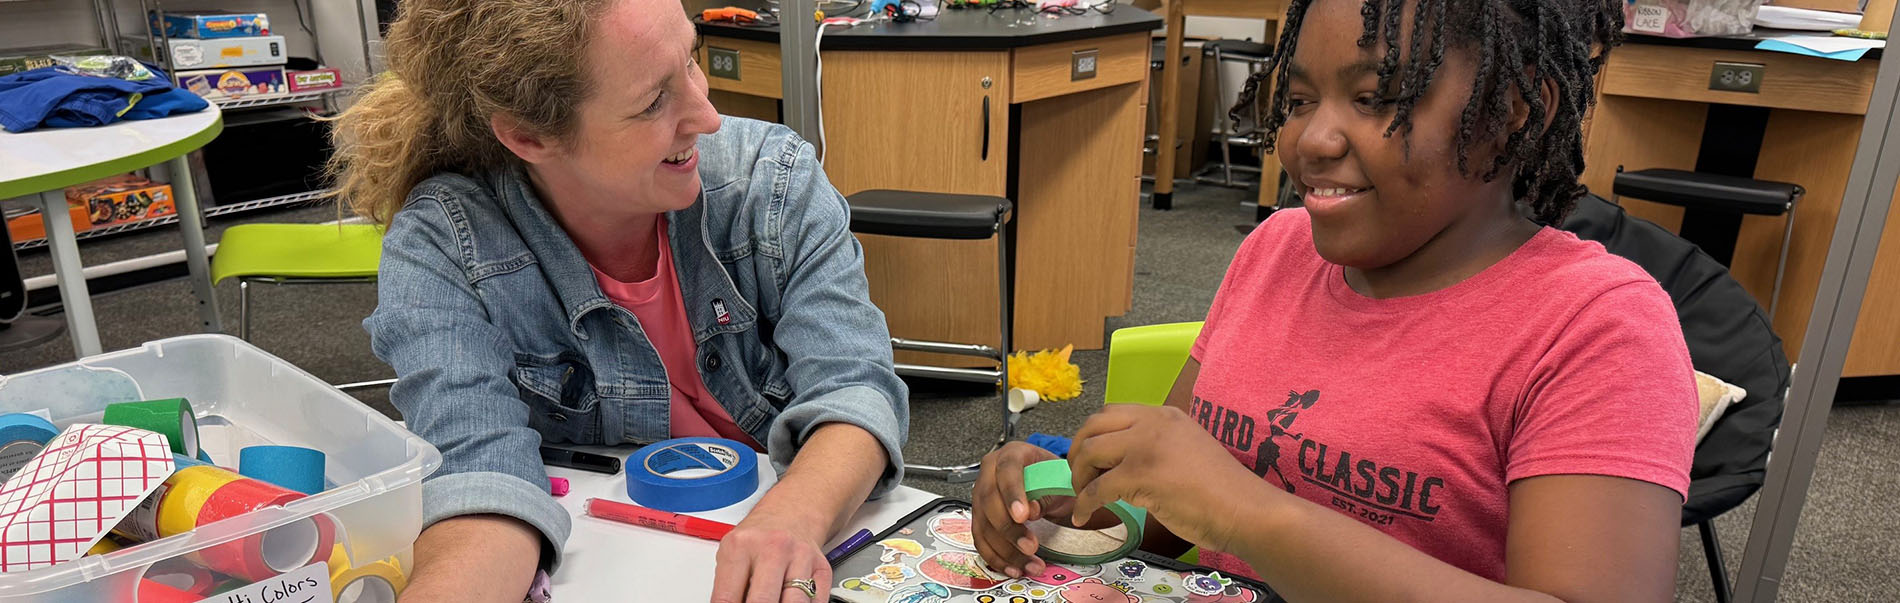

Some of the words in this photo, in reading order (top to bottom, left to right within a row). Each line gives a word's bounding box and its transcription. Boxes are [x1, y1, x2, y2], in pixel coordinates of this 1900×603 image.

[1636, 18, 1661, 28] LACE
[1637, 7, 1662, 16] RIBBON
[1299, 438, 1444, 515] CLASSIC
[1331, 496, 1357, 515] EST.
[1359, 508, 1395, 526] 2021
[261, 577, 317, 603] Colors
